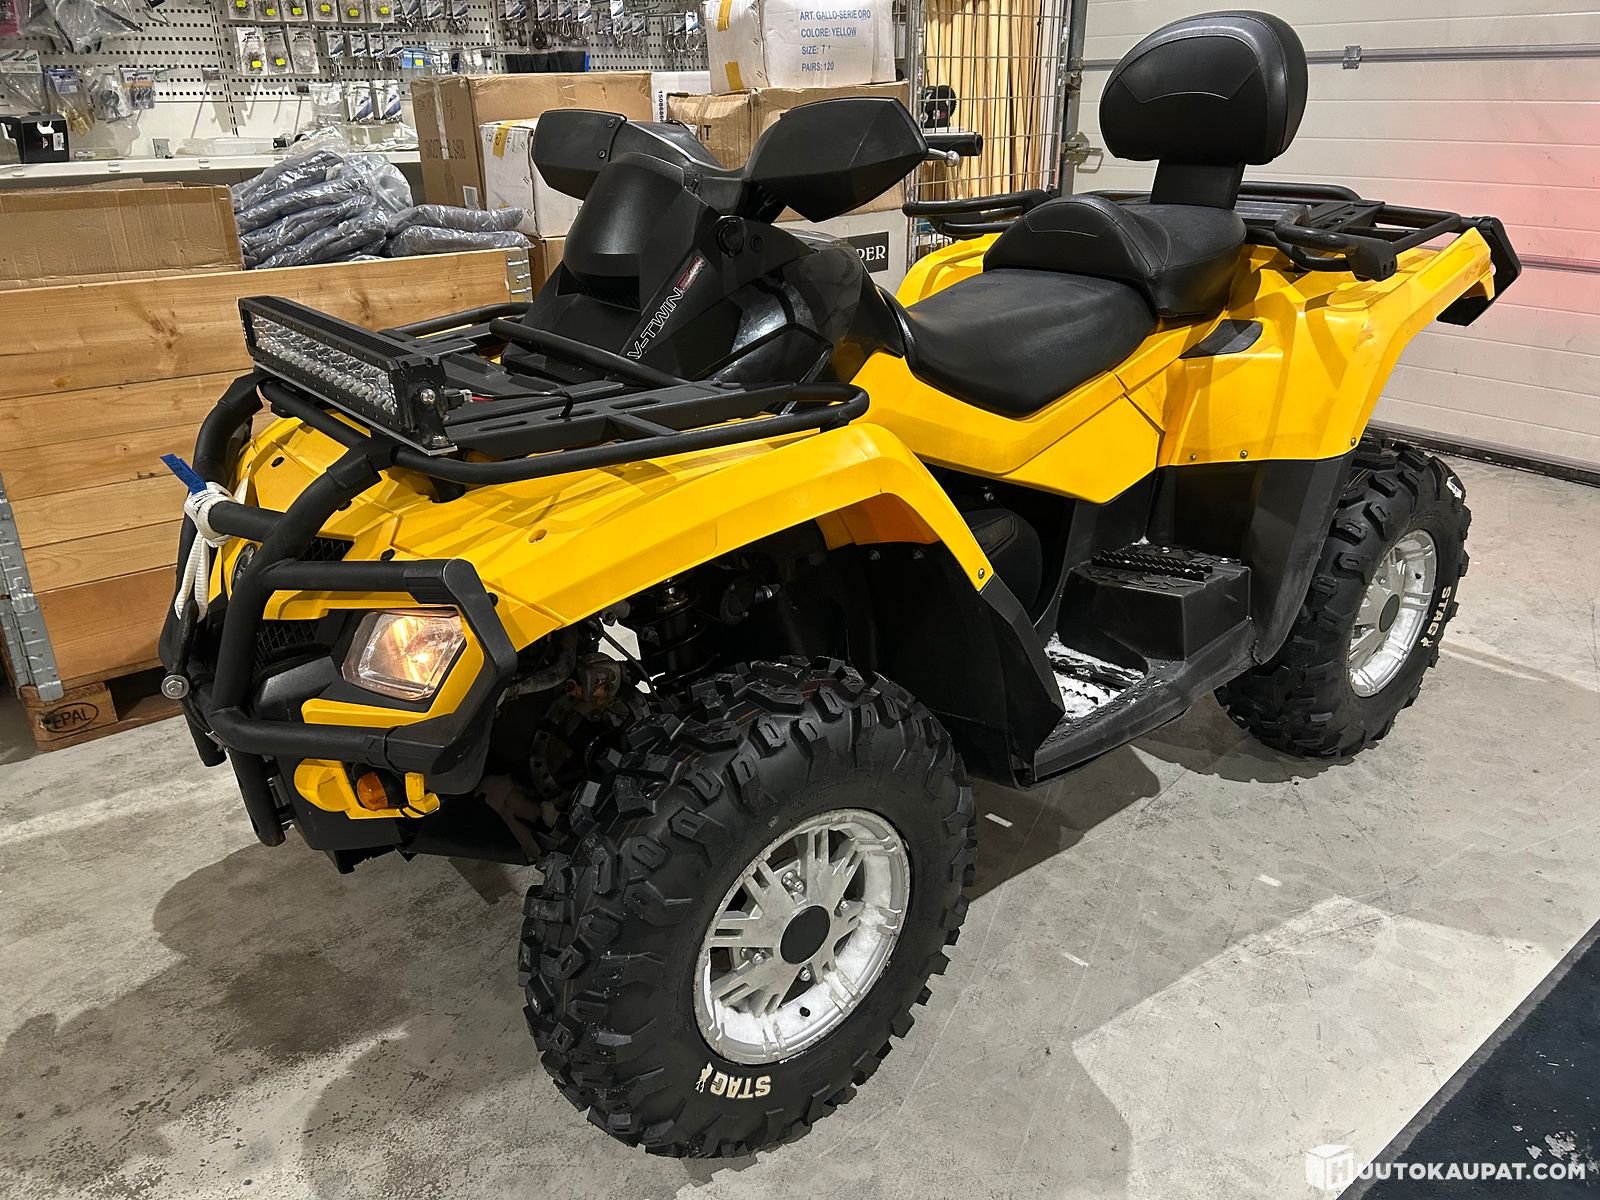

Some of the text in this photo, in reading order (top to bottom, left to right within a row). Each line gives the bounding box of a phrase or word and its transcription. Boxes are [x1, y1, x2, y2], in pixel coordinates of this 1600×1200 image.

[799, 9, 871, 21] ART. GALLO-SERIE ORO
[800, 27, 857, 38] COLORE: YELLOW
[801, 45, 819, 55] SIZE:
[801, 62, 835, 72] PAIRS: 120
[627, 286, 684, 360] V-TWIN
[1426, 585, 1452, 636] STAG
[52, 708, 92, 729] EPAL
[710, 1070, 771, 1099] STAG
